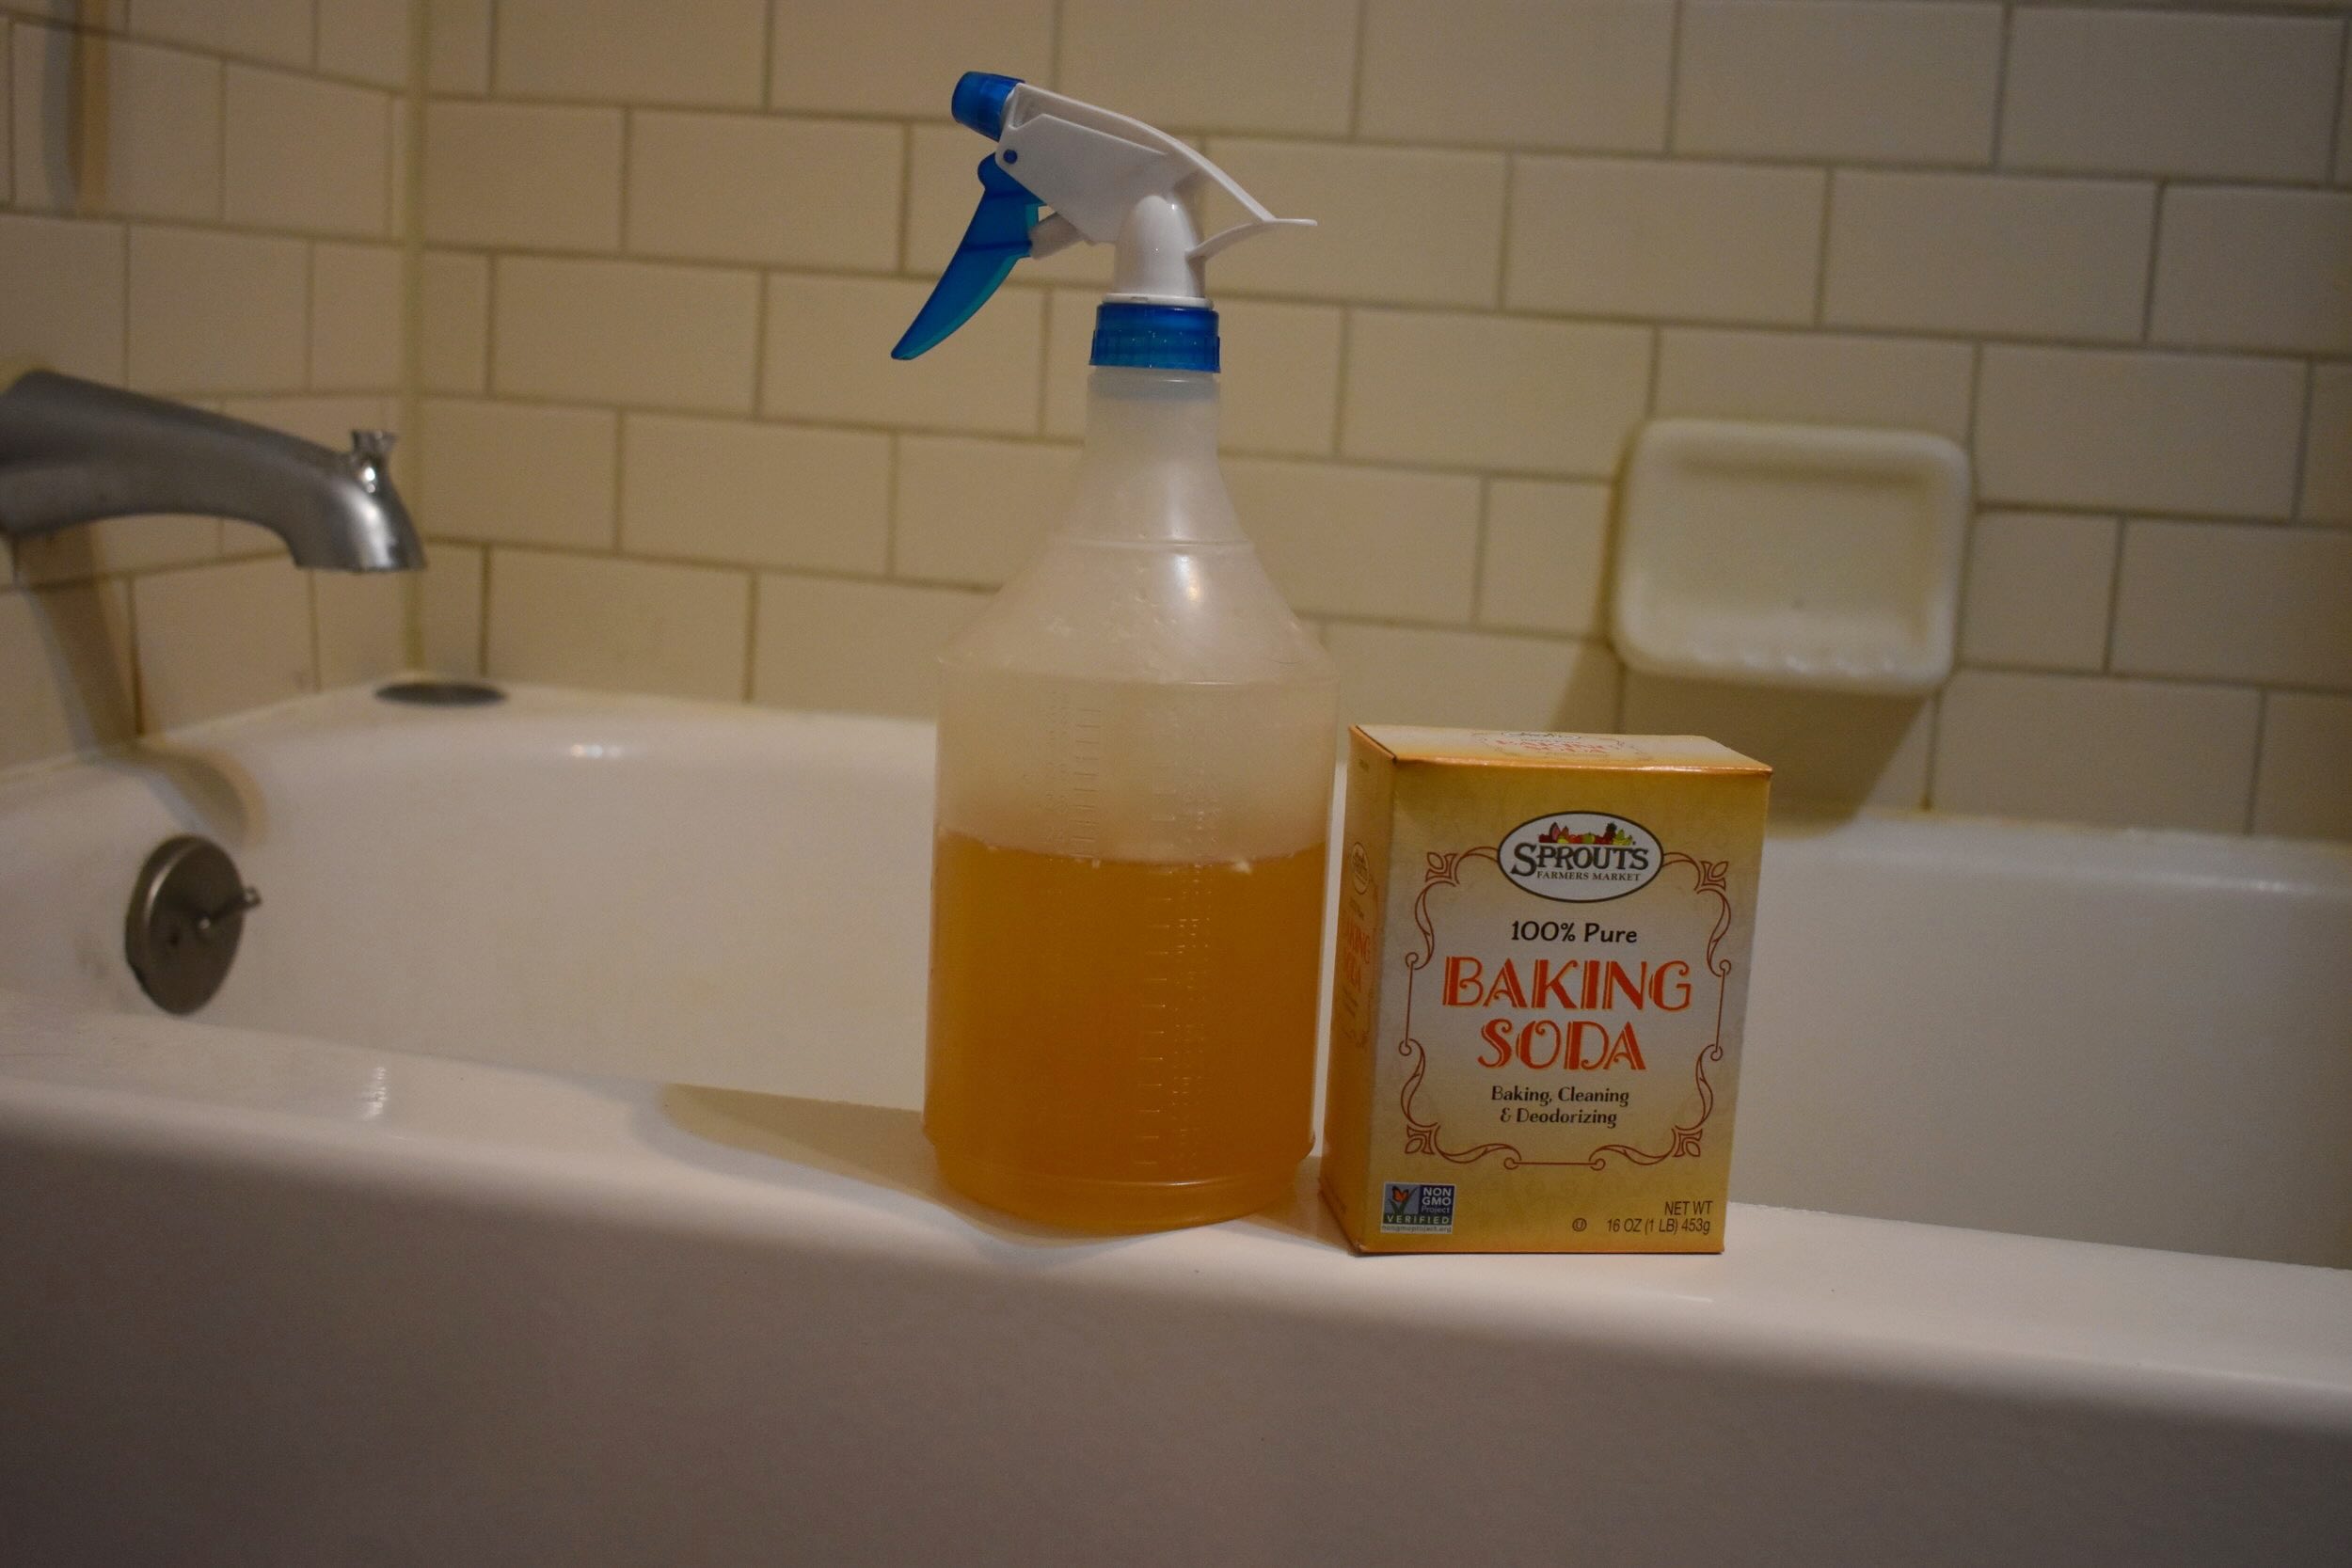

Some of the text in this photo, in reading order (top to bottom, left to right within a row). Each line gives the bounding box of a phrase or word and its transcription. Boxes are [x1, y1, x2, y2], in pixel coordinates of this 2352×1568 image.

[1510, 842, 1649, 877] SPROUTS
[1536, 870, 1642, 881] FARMERS MARKET
[1511, 921, 1638, 942] 100% Pure
[1442, 956, 1692, 1012] BAKING
[1477, 1018, 1646, 1070] SODA
[1491, 1085, 1630, 1108] Baking, Cleaning
[1500, 1107, 1617, 1129] & Deodorizing
[1422, 1187, 1452, 1197] NON
[1422, 1196, 1452, 1206] GMO
[1664, 1200, 1713, 1216] NET WT
[1387, 1214, 1450, 1225] VERIFIED
[1607, 1217, 1710, 1235] 16 OZ (1 LB) 453g
